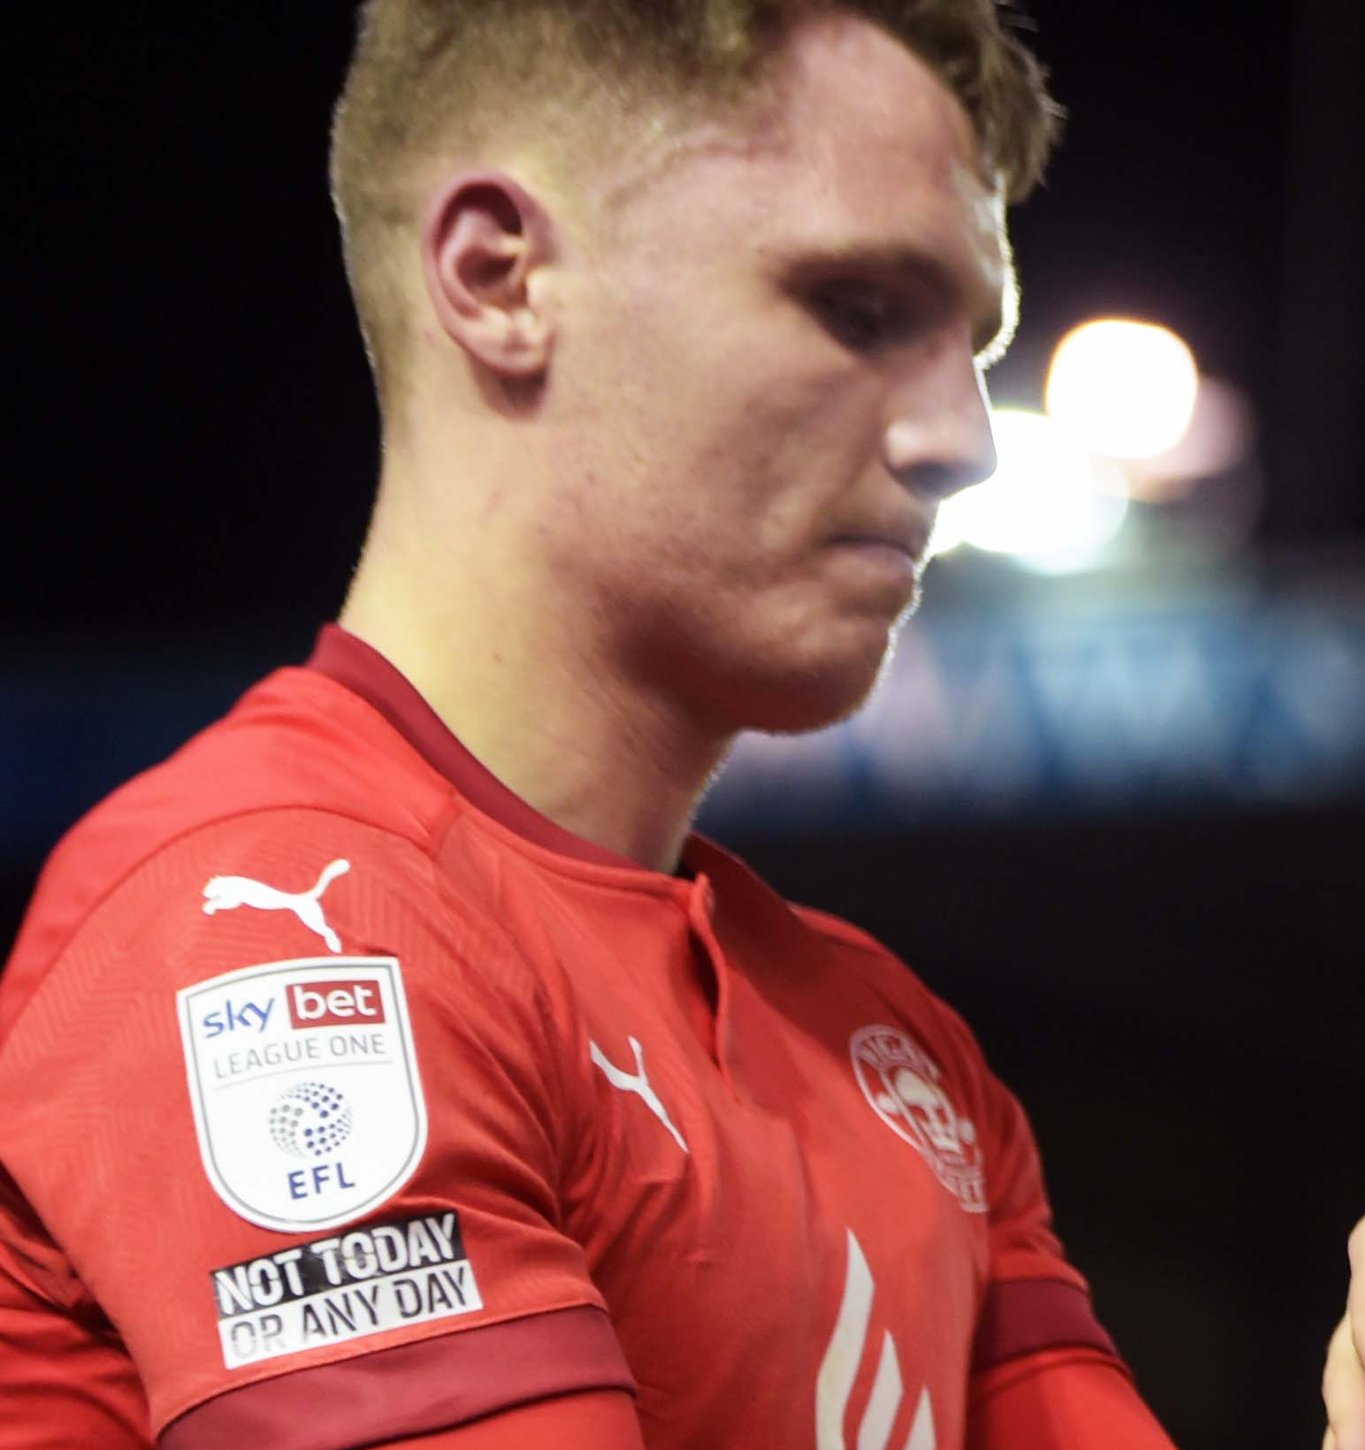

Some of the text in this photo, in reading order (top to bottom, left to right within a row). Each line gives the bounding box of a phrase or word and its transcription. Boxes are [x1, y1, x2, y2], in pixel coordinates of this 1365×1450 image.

[203, 984, 376, 1039] sky bet
[214, 1033, 386, 1080] LEAGUE ONE
[288, 1162, 356, 1200] EFL
[216, 1212, 456, 1314] NOT TODAY
[229, 1266, 468, 1360] OR ANY DAY
